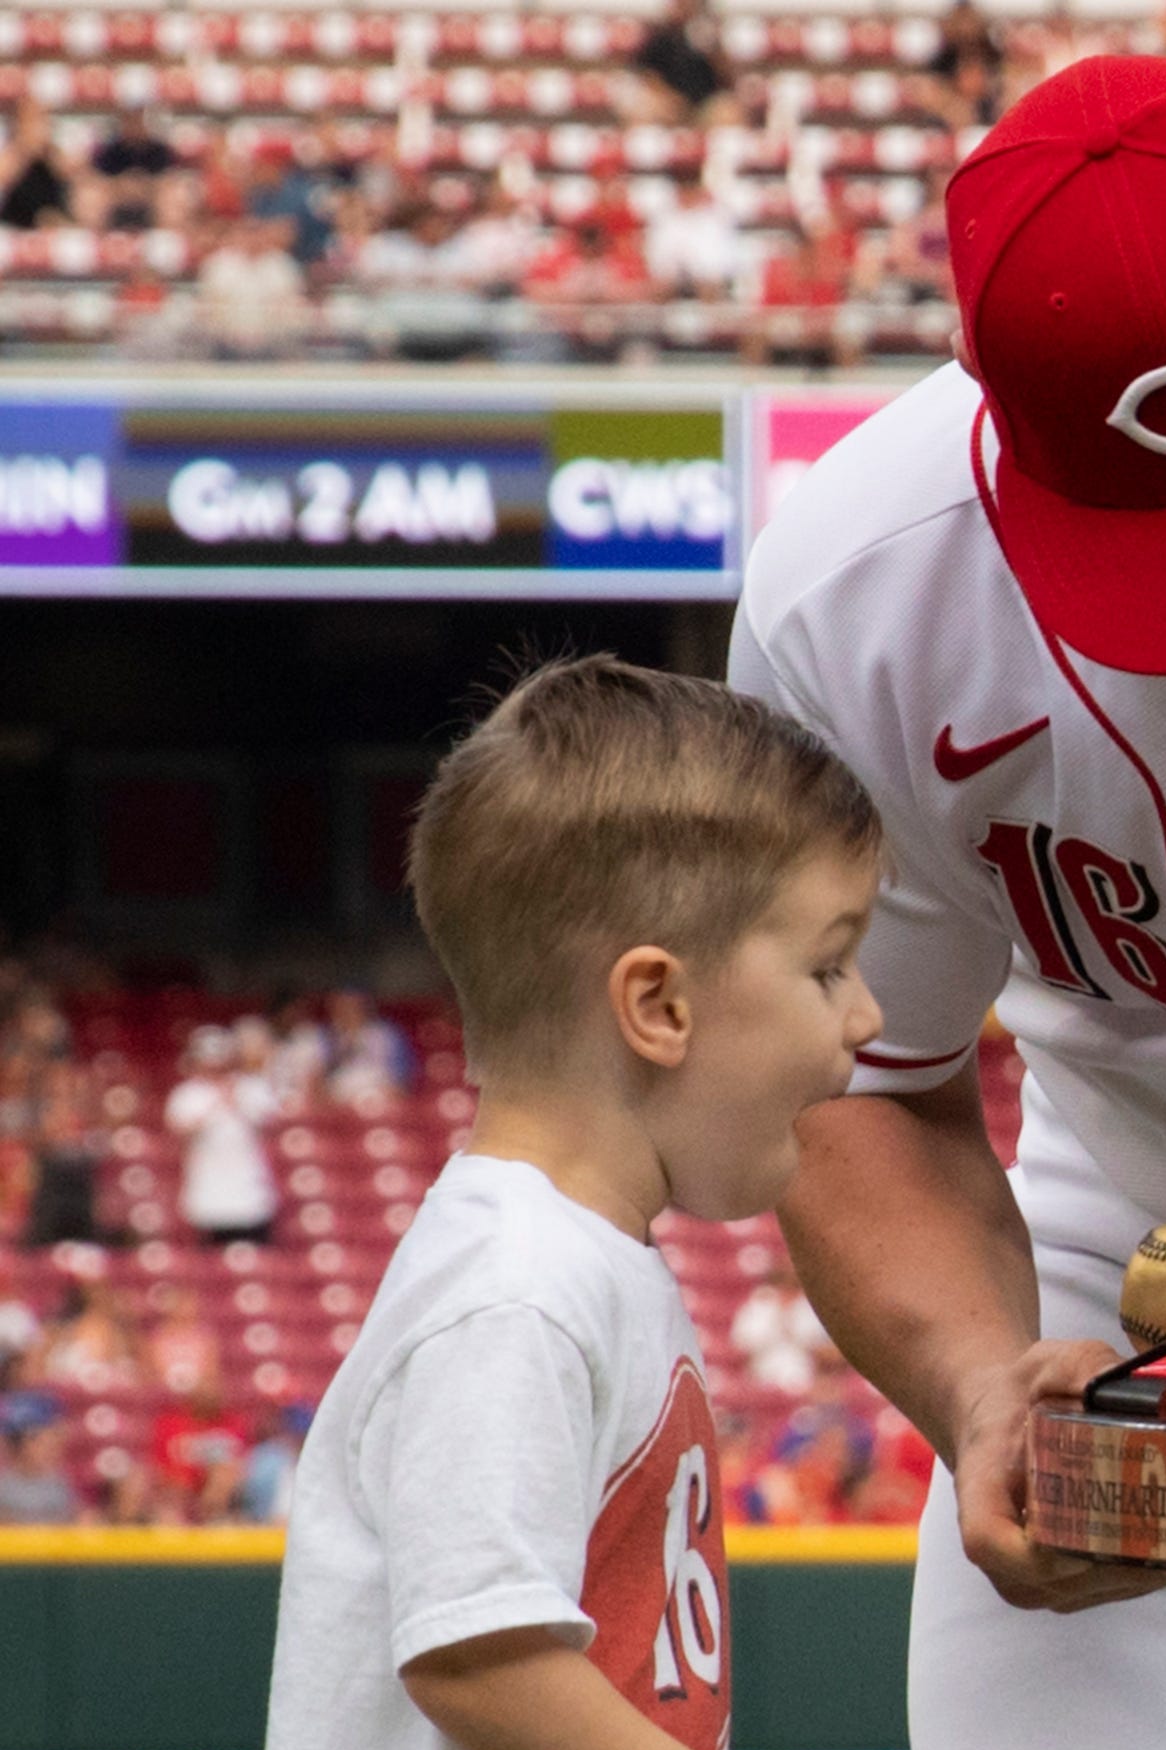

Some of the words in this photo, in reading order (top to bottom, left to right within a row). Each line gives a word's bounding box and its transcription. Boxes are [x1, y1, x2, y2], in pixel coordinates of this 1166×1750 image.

[297, 461, 352, 543] 2
[355, 461, 498, 543] AM
[548, 456, 735, 539] CWS
[654, 1444, 722, 1701] 16
